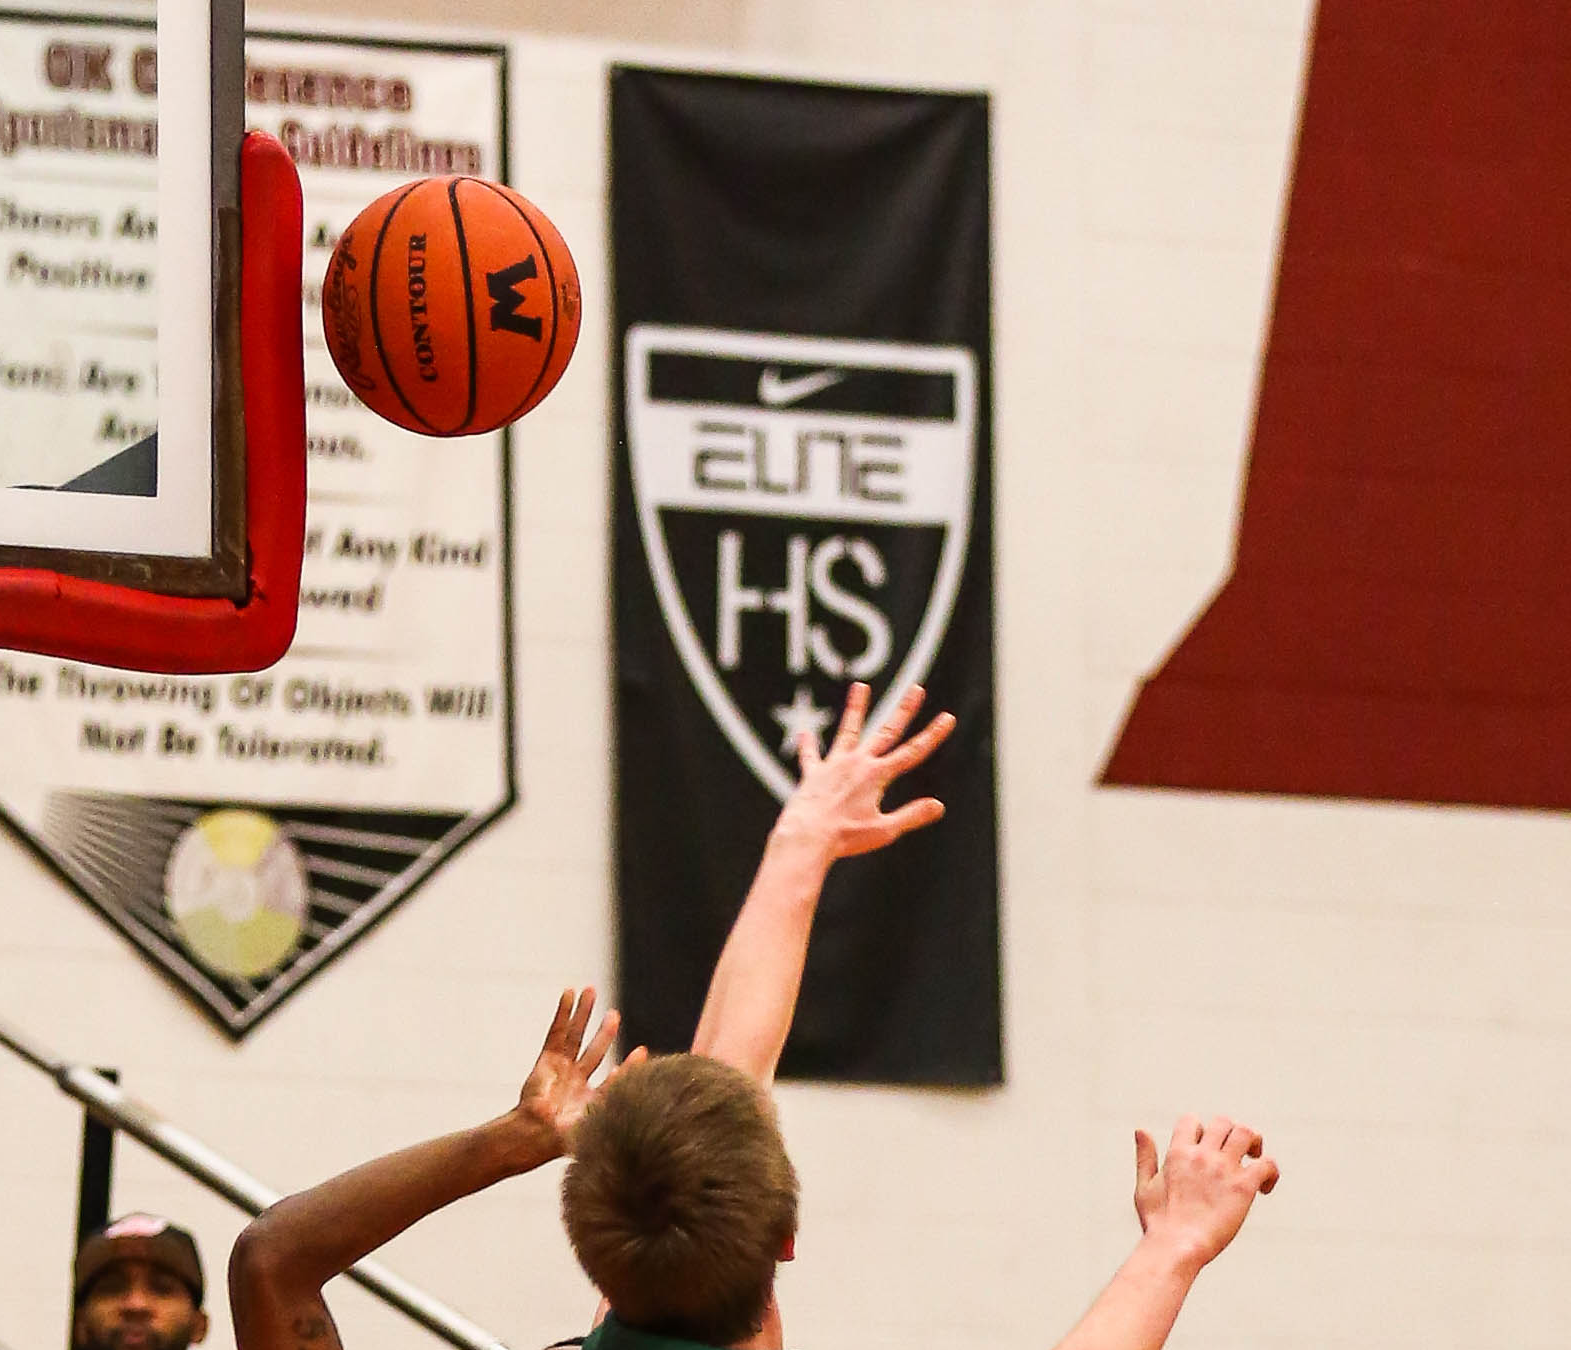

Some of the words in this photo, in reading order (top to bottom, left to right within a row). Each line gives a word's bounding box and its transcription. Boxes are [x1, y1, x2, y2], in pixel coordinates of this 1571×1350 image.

[407, 232, 438, 383] CONTOUR
[691, 417, 907, 503] ELITE
[716, 528, 893, 682] HS
